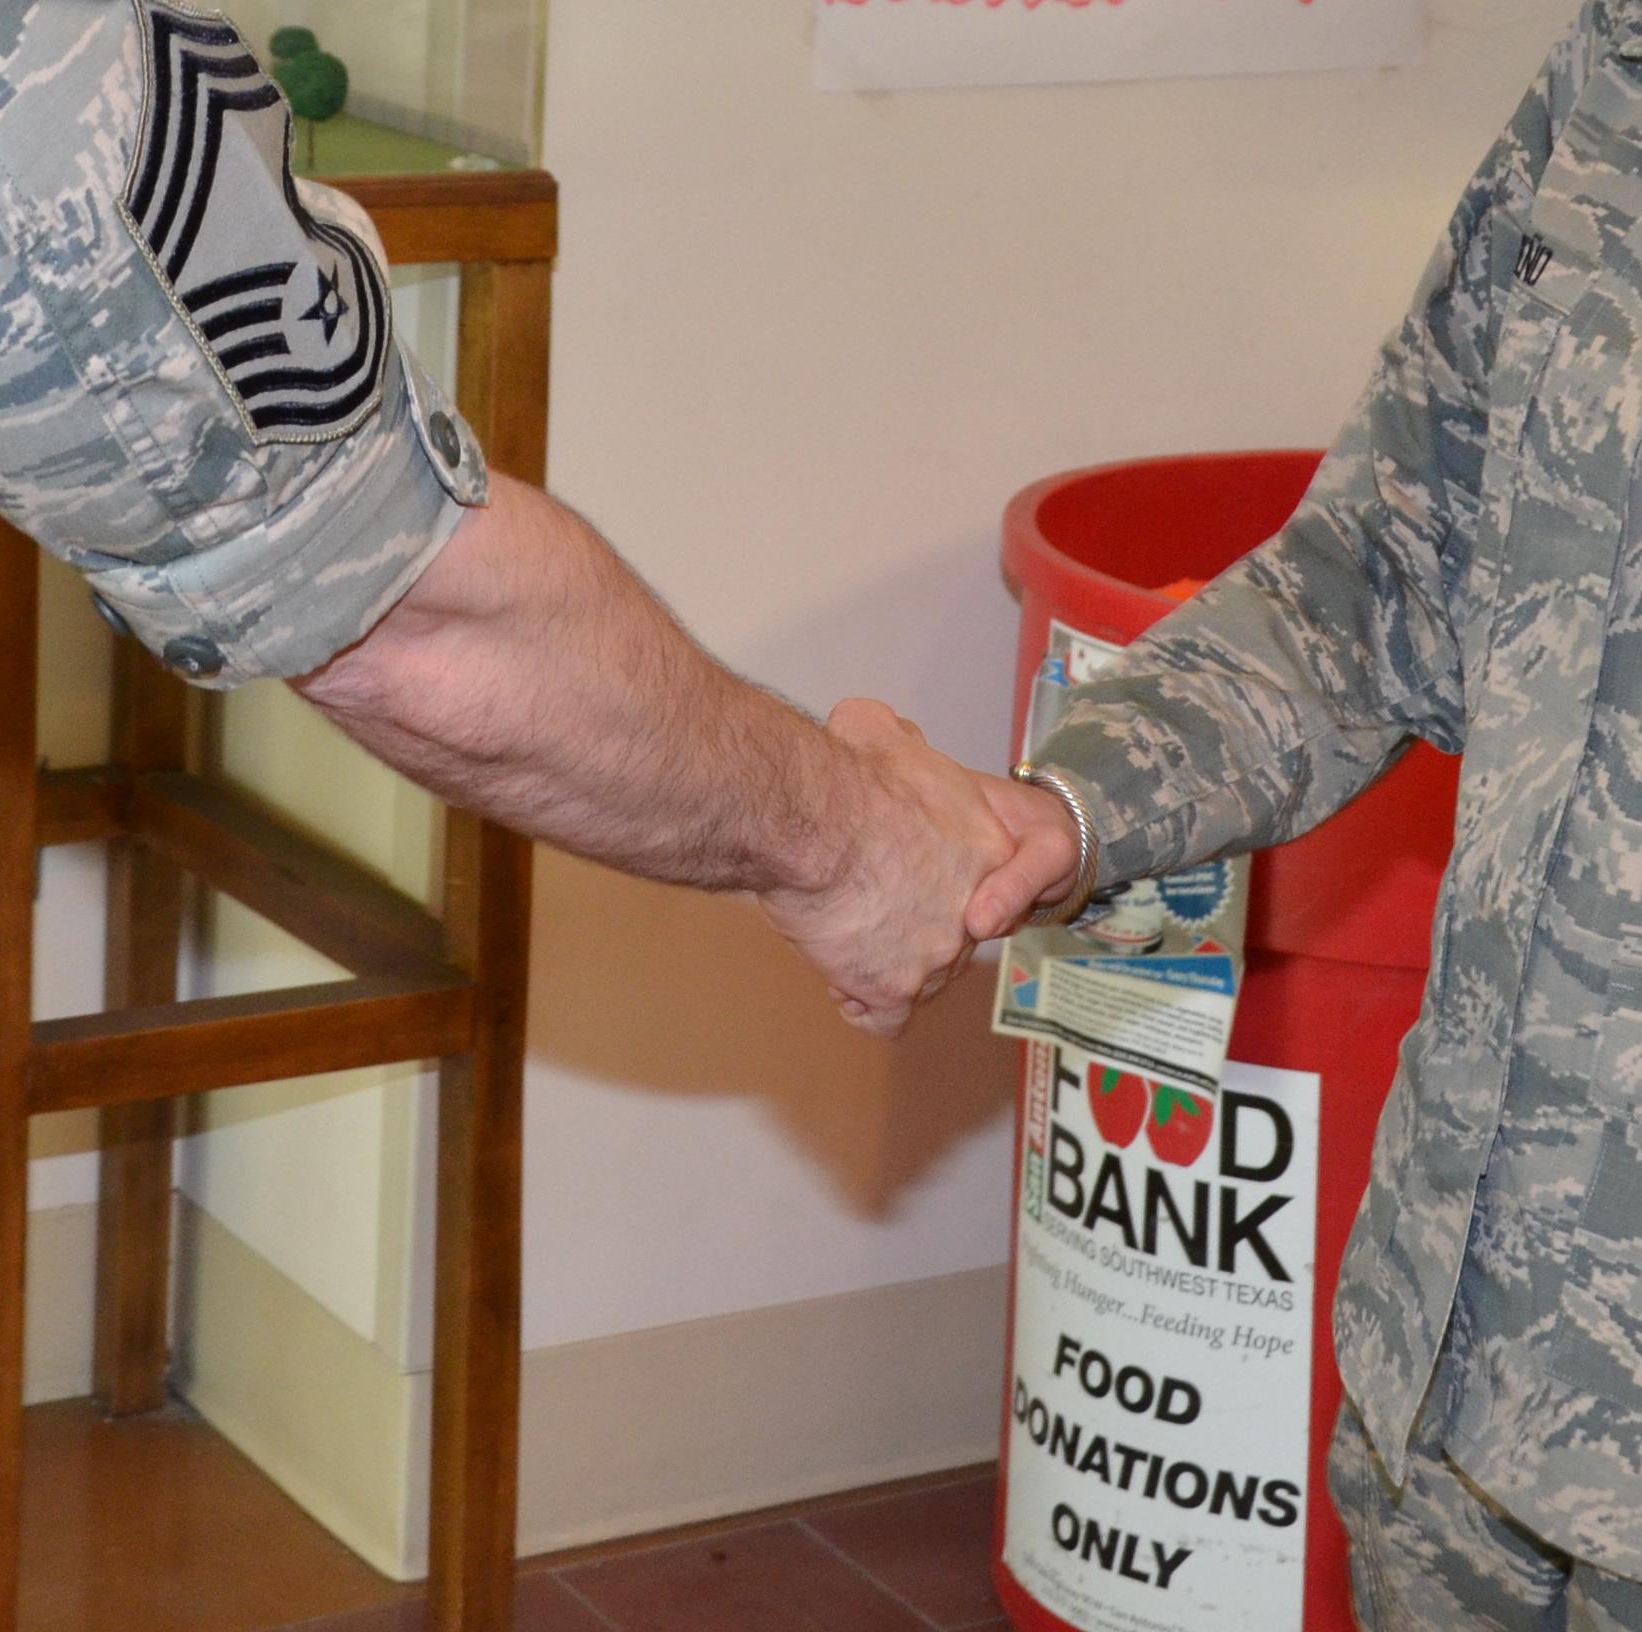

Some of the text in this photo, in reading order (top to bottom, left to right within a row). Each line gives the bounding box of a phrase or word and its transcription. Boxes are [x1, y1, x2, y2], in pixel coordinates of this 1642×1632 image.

[1046, 1119, 1296, 1283] BANK
[1100, 1245, 1219, 1298] SOUTHWEST
[1223, 1279, 1295, 1312] TEXAS
[1052, 1333, 1202, 1425] FOOD
[1231, 1324, 1295, 1359] Hope
[1012, 1375, 1301, 1528] DONATIONS
[1050, 1501, 1193, 1589] ONLY
